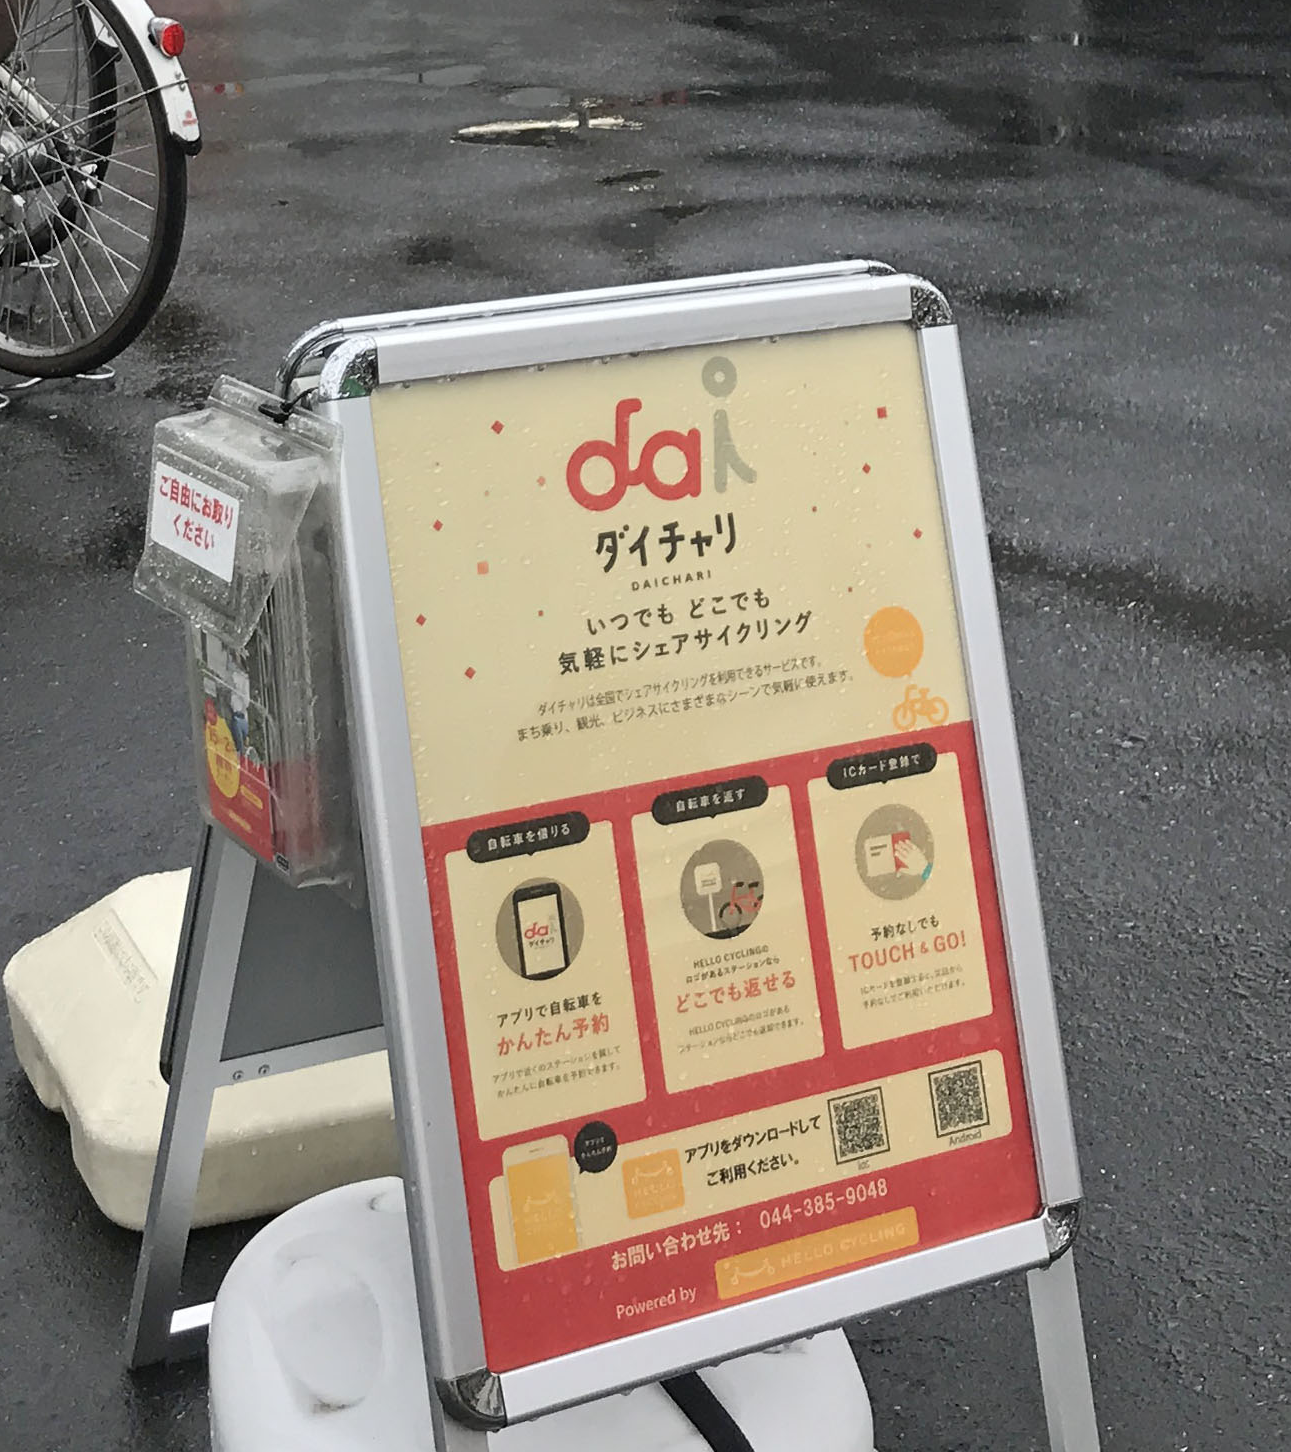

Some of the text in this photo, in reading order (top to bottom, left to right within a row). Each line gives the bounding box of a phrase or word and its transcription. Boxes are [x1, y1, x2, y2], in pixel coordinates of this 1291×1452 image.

[566, 355, 757, 512] dai
[159, 475, 234, 530] ご自由にお取り
[173, 513, 215, 551] ください
[595, 511, 737, 573] ダイチャリ
[630, 569, 713, 592] DAICHARI
[586, 586, 772, 636] いつでも どこでも
[557, 609, 813, 675] 気軽にシェアサイクリング
[843, 753, 922, 778] ICカード登録で
[676, 787, 747, 813] 自転車を返す
[486, 822, 571, 852] 自転車を借りる
[870, 914, 940, 941] 予約なしでも
[848, 930, 967, 973] TOUCH & GO!
[496, 991, 603, 1028] アプリで自転車を
[675, 970, 797, 1014] どこでも返せる
[496, 1013, 610, 1057] かんたん予約
[684, 1114, 822, 1164] アプリをダウンロードして
[948, 1129, 983, 1147] Android
[706, 1151, 801, 1187] ご利用ください。
[759, 1177, 888, 1230] 044-385-9048
[616, 1291, 677, 1320] Powered
[679, 1286, 697, 1304] by
[780, 1241, 833, 1269] HELLO
